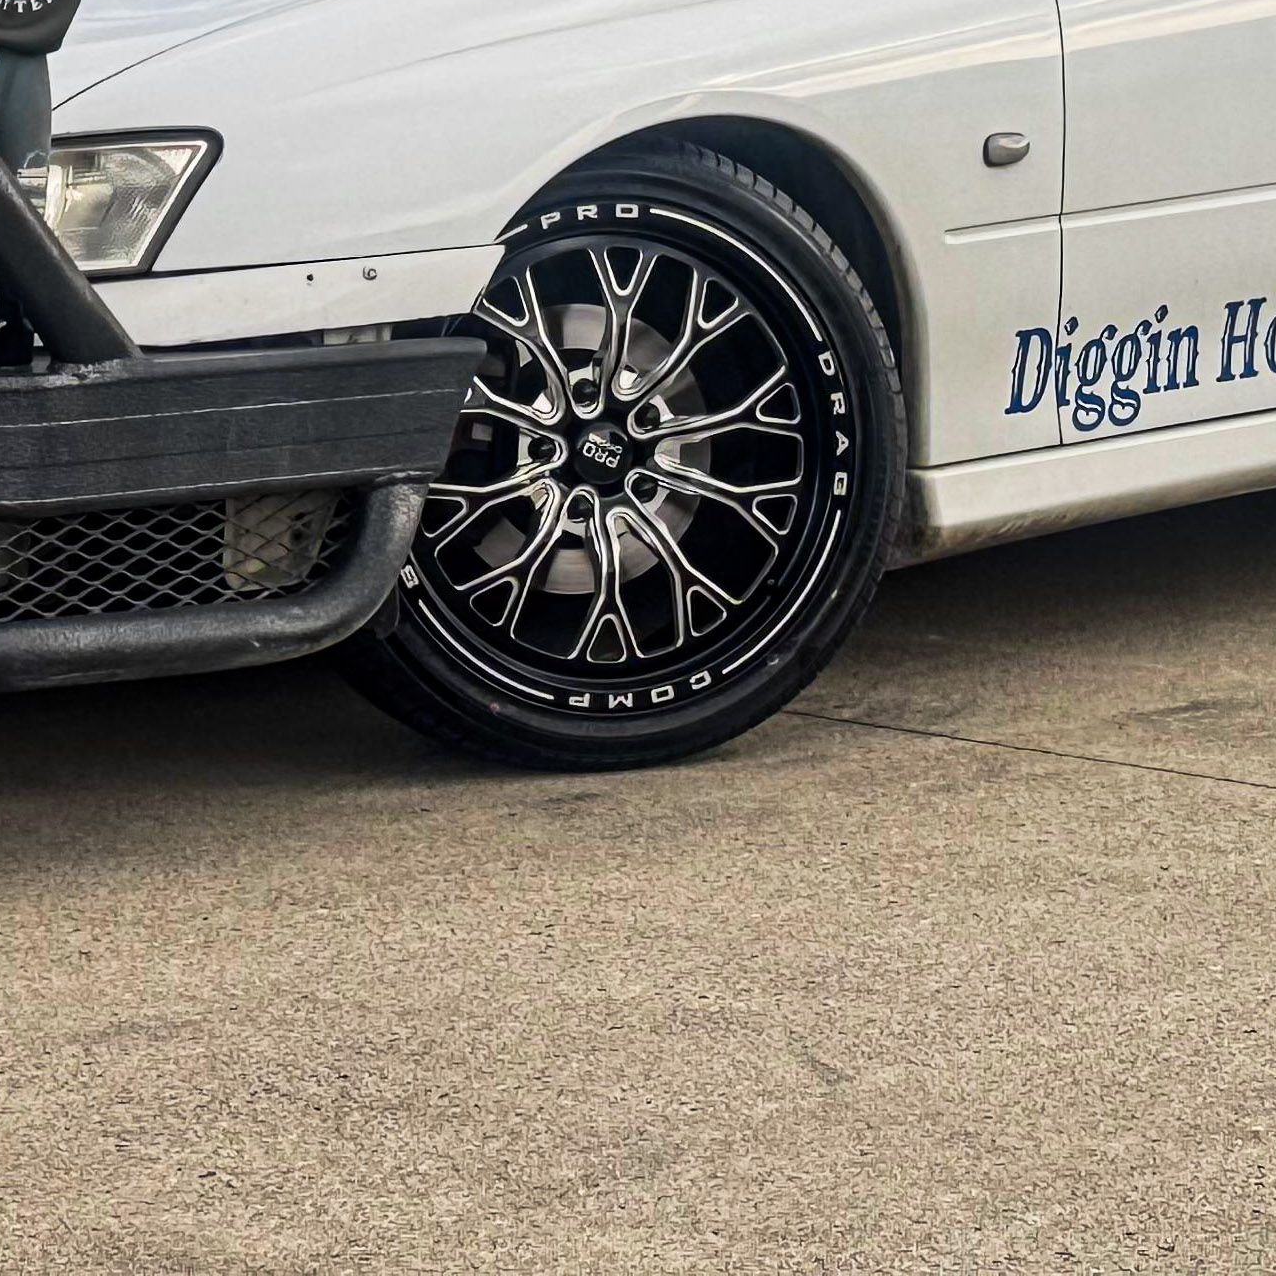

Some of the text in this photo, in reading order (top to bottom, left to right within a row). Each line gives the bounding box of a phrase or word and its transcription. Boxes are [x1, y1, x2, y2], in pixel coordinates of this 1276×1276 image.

[540, 203, 640, 230] PRO
[1004, 304, 1201, 431] Diggin
[819, 351, 850, 497] DRAG
[568, 670, 711, 709] COMP
